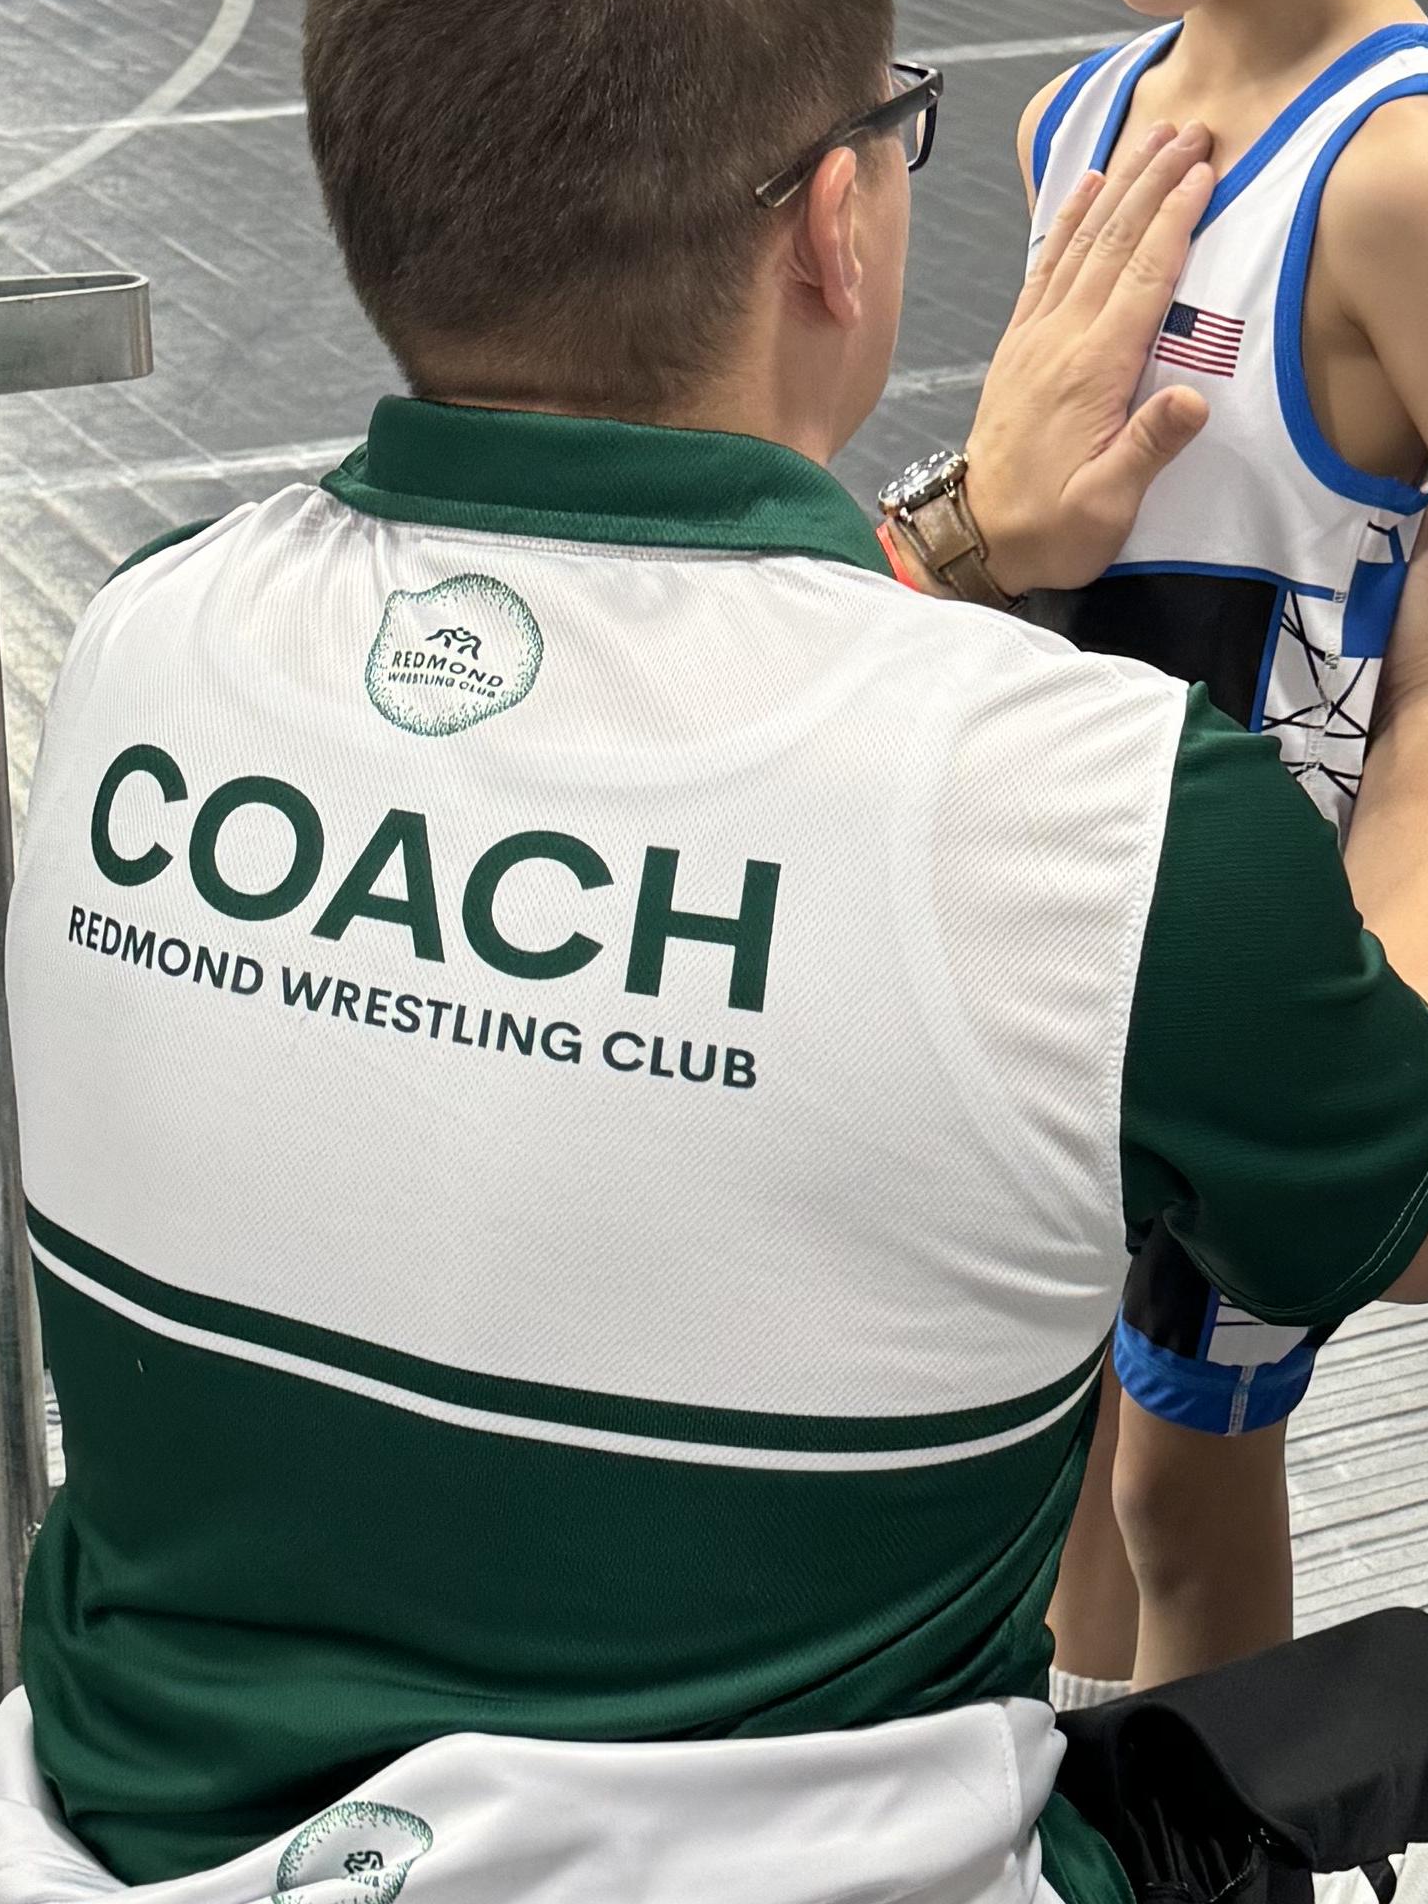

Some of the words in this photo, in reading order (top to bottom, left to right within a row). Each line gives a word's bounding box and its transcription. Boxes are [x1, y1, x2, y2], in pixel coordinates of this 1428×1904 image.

[387, 671, 456, 688] WRESTLING
[459, 681, 496, 698] CLUB
[391, 650, 504, 687] REDMOND
[91, 742, 782, 1013] COACH
[67, 905, 264, 996] REDMOND
[281, 966, 583, 1065] WRESTLING
[601, 1030, 758, 1090] CLUB
